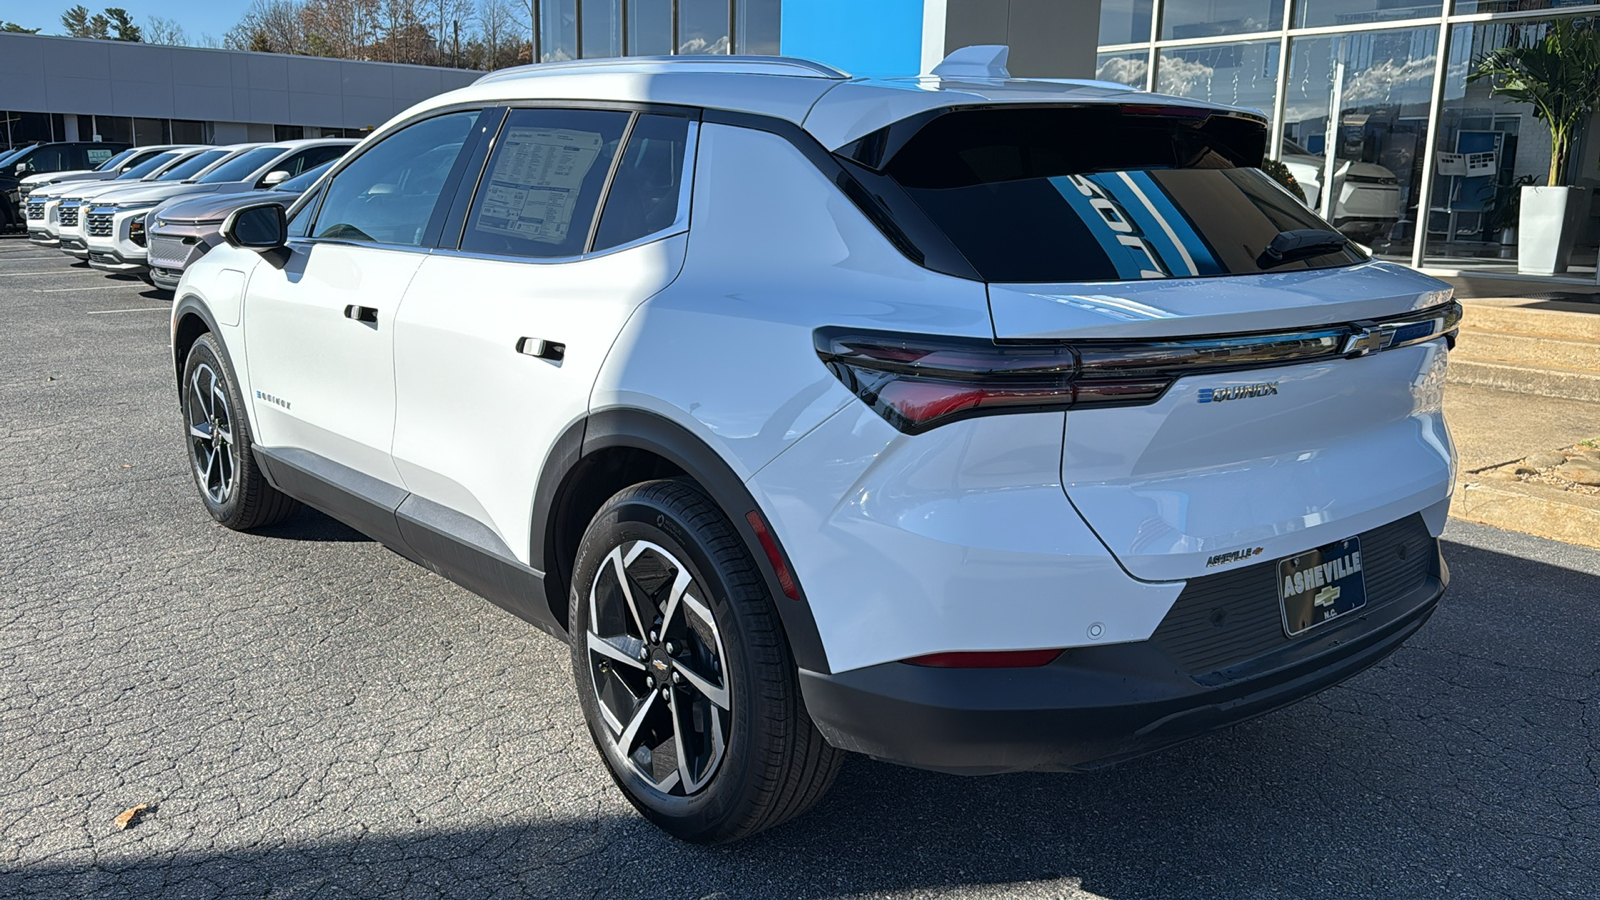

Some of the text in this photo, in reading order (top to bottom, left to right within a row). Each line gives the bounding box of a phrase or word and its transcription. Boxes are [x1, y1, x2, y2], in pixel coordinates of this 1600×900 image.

[1197, 381, 1279, 403] EQUINOX
[1206, 547, 1253, 568] ASHEVILLE
[1284, 551, 1361, 598] ASHEVILLE
